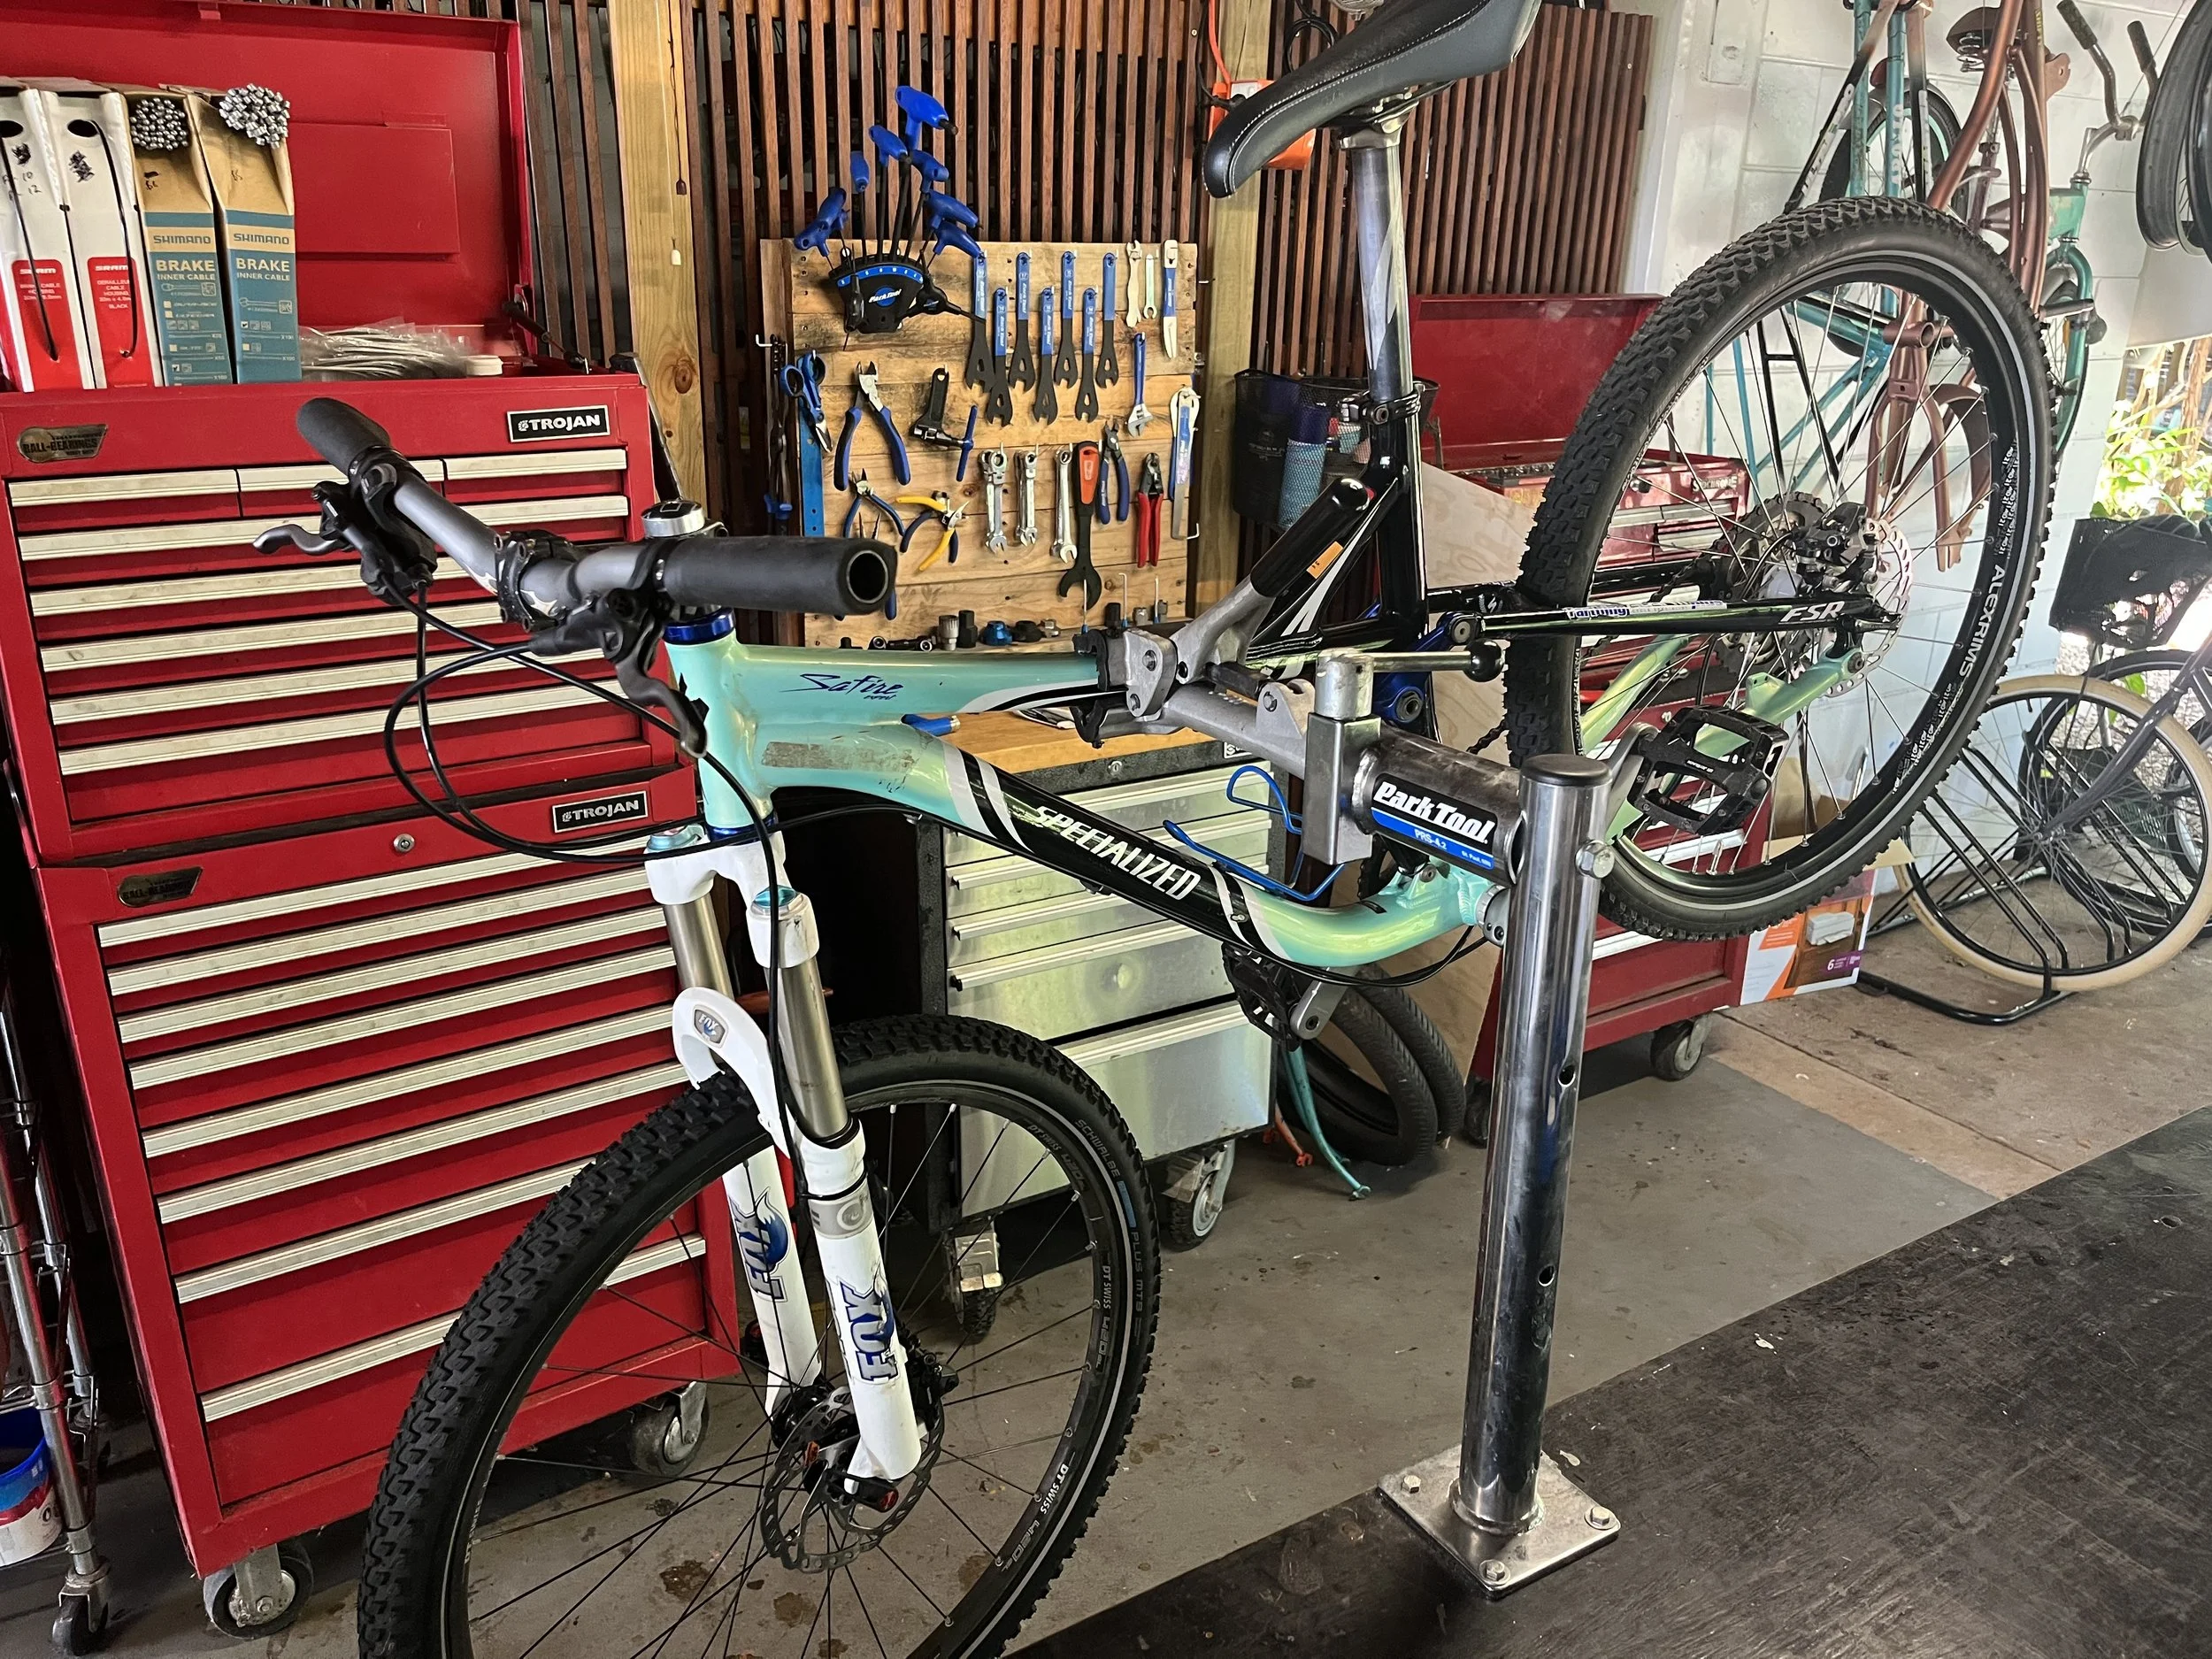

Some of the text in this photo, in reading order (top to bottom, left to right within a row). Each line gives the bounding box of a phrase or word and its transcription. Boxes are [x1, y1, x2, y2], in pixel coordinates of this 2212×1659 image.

[153, 234, 211, 244] SHIMANO
[234, 233, 290, 245] SHIMANO
[156, 259, 216, 273] BRAKE
[235, 257, 290, 273] BRAKE
[236, 272, 290, 281] INNER CABLE
[528, 414, 601, 432] TROJAN
[1779, 601, 1845, 622] FSR
[1959, 564, 2007, 678] ALEXRIMS
[572, 799, 640, 821] TROJAN
[1035, 805, 1202, 902] SPECIALIZED
[1827, 958, 1836, 971] 6
[698, 1013, 719, 1031] FOX
[1040, 1133, 1062, 1151] SWISS
[1074, 1119, 1121, 1178] SCHWALBE
[1130, 1231, 1143, 1273] PLUS
[1102, 1264, 1111, 1281] DT
[1102, 1281, 1112, 1310] SWISS
[1134, 1279, 1143, 1312] MTB
[841, 1280, 899, 1382] FOX
[1056, 1463, 1070, 1485] DT
[1040, 1482, 1061, 1515] SWISS
